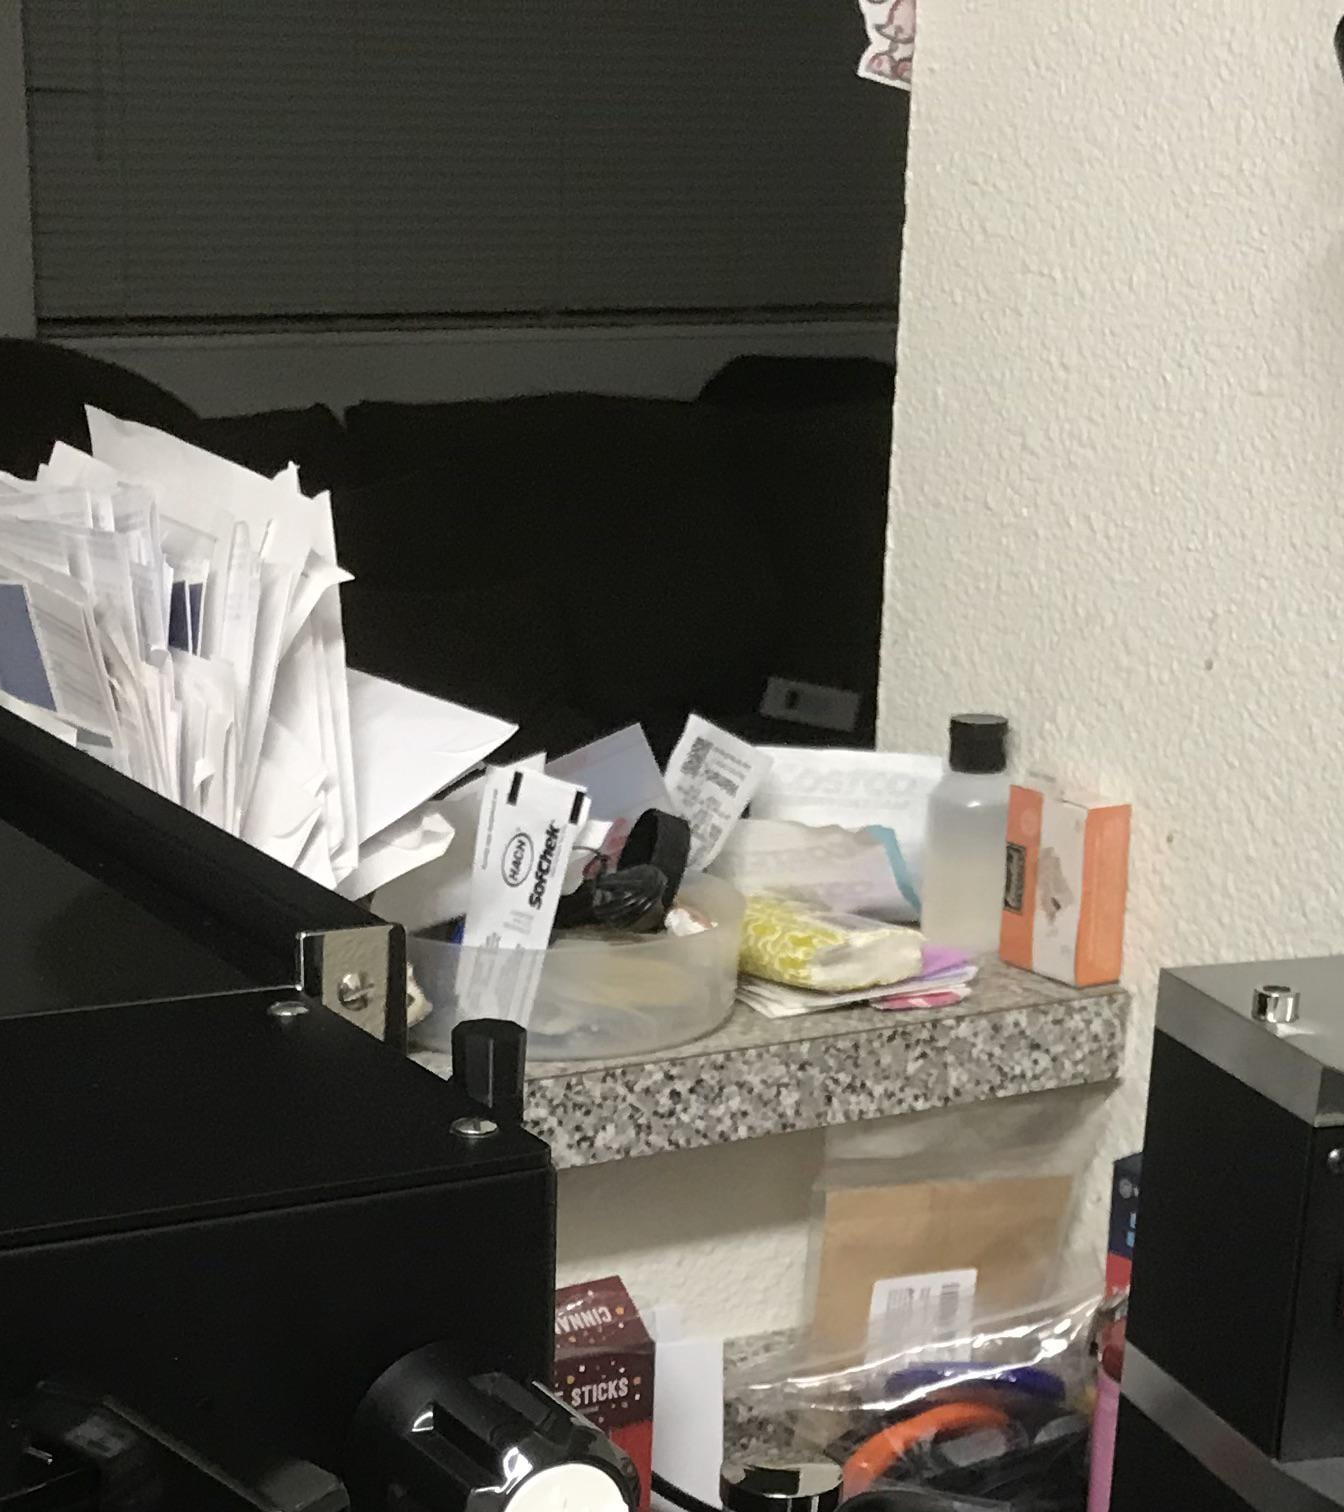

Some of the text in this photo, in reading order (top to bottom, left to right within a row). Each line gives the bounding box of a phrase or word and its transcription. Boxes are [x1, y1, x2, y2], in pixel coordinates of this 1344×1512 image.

[508, 839, 527, 882] HACH
[528, 822, 561, 911] SofChek
[571, 1376, 630, 1407] STICKS
